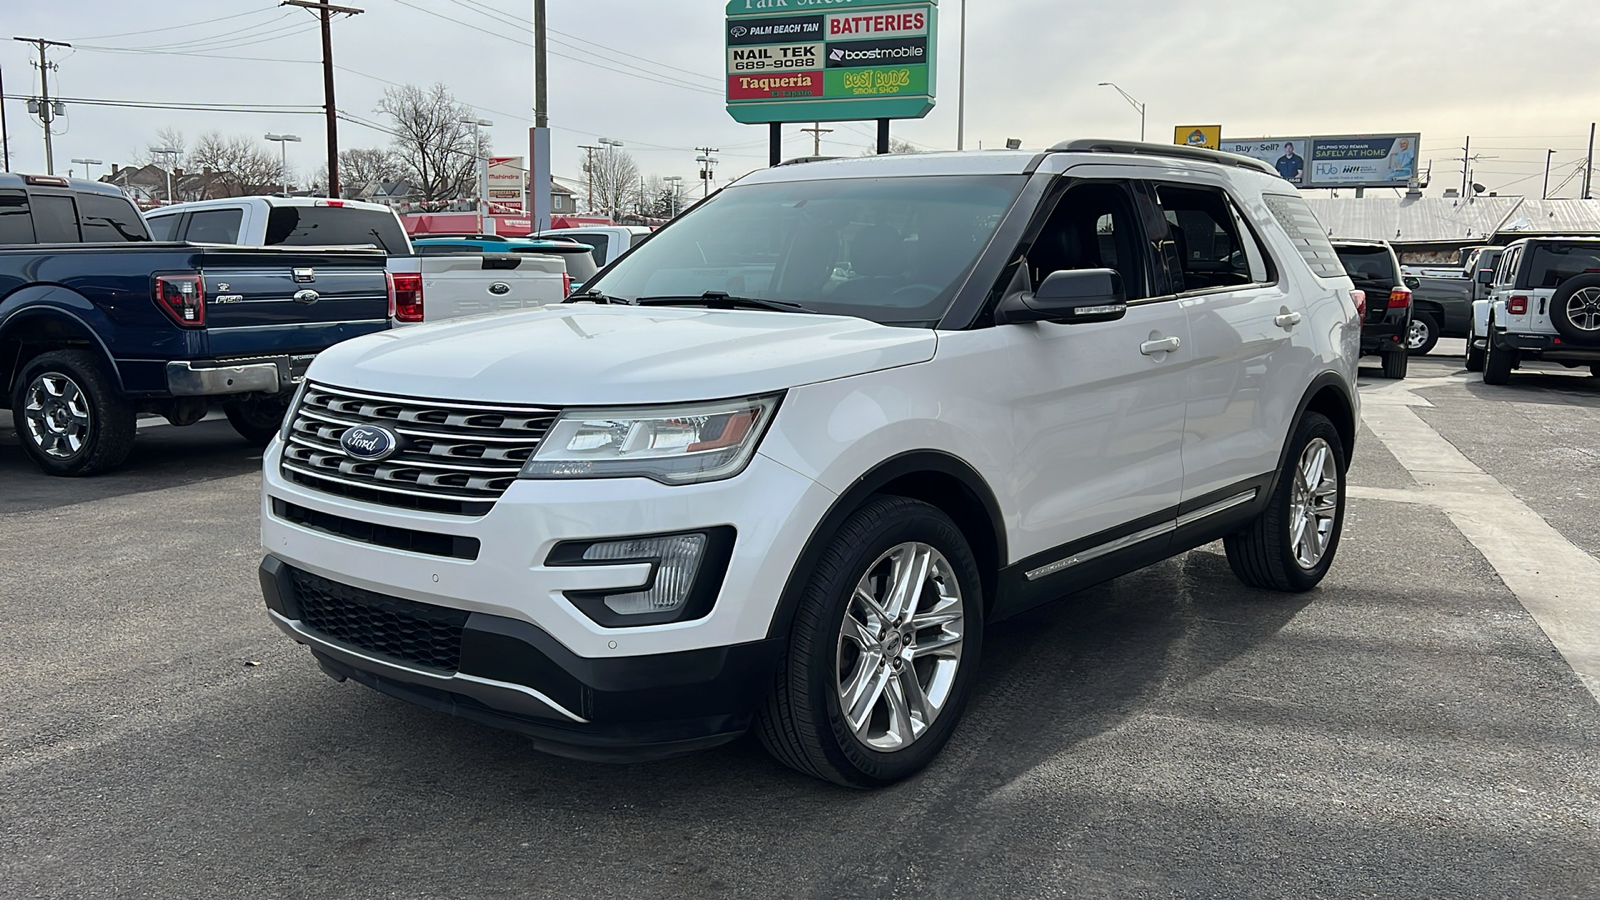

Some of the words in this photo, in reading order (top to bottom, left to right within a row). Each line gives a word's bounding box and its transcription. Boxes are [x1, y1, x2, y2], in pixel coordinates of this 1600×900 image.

[750, 26, 772, 36] PALM
[773, 24, 801, 35] BEACH
[803, 22, 819, 33] TAN
[830, 12, 924, 35] BATTERIES
[733, 49, 772, 61] NAIL
[779, 46, 816, 58] TEK
[735, 58, 815, 71] 689-9088
[875, 68, 910, 87] BUDZ
[852, 87, 878, 95] SMOKE
[879, 86, 900, 94] SHOP
[1235, 144, 1252, 153] Buy
[1260, 143, 1280, 151] Sell?
[1315, 149, 1346, 158] SAFELY
[1347, 149, 1359, 157] AT
[1360, 148, 1386, 156] HOME
[347, 429, 380, 452] Ford
